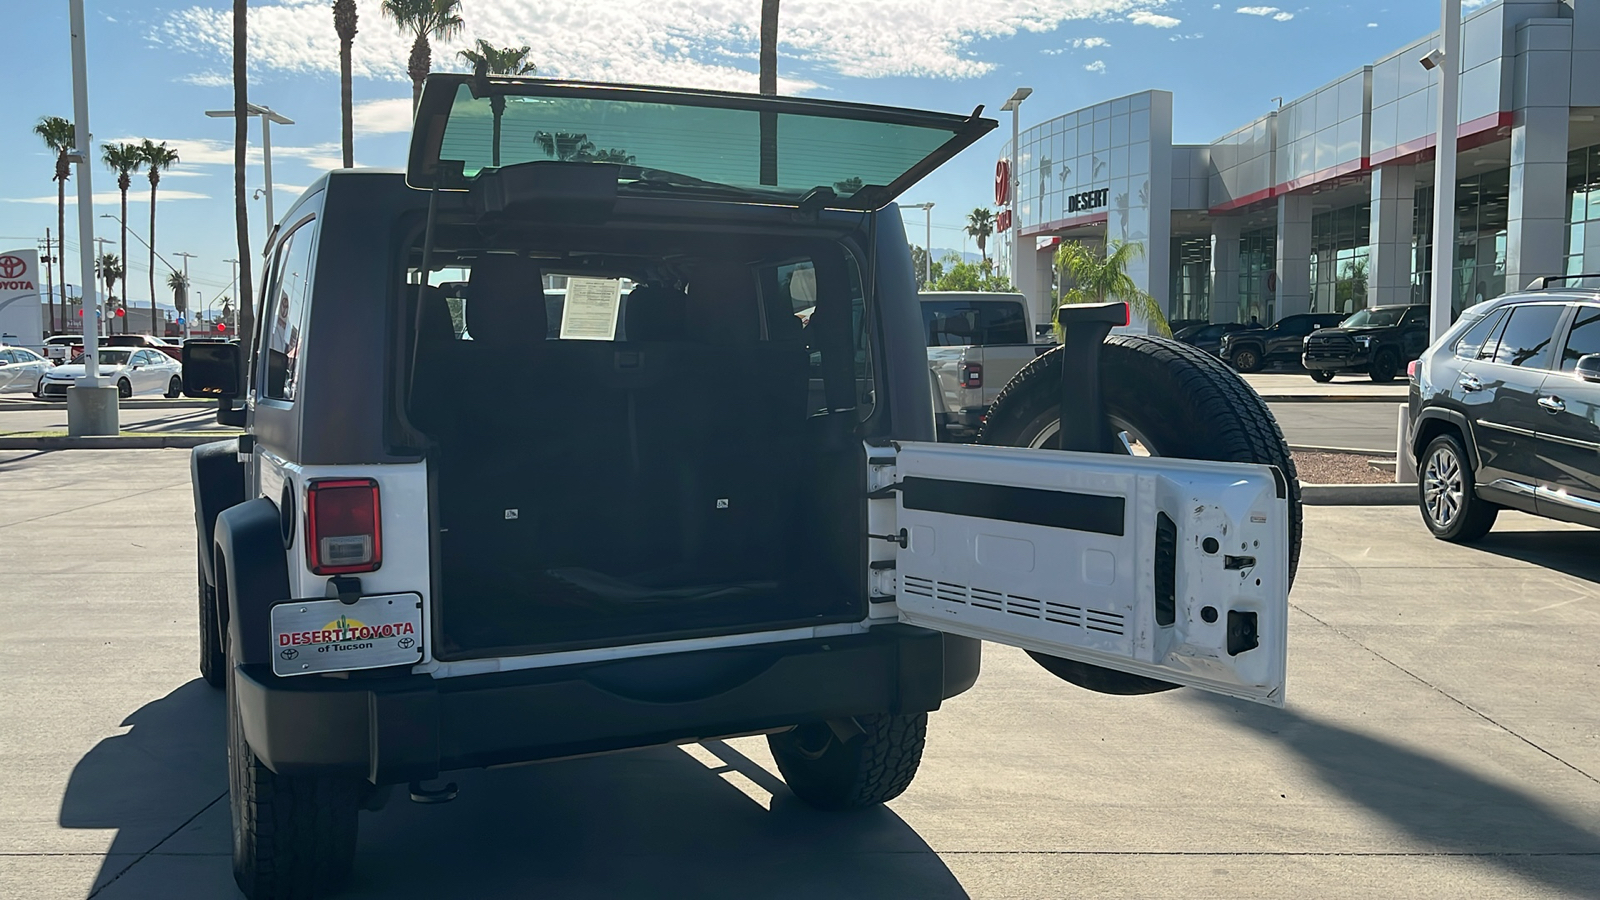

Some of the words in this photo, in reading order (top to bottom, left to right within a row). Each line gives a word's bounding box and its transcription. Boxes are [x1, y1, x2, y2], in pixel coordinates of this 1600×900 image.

[1068, 188, 1109, 213] DESERT
[0, 281, 34, 290] YOTA
[279, 629, 343, 647] DESERT
[350, 622, 414, 640] TOYOTA
[317, 645, 329, 653] of
[332, 642, 373, 652] Tucson
